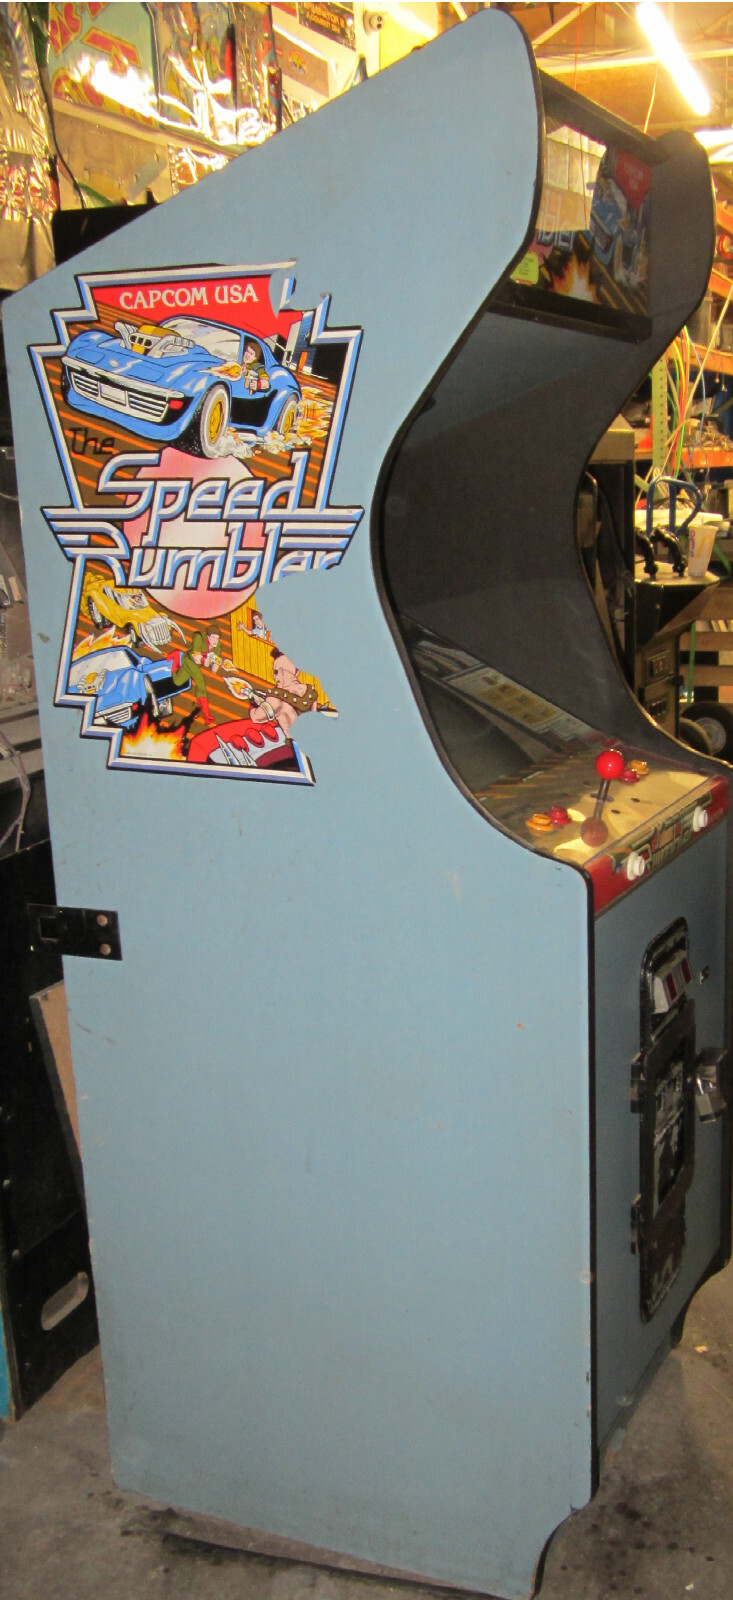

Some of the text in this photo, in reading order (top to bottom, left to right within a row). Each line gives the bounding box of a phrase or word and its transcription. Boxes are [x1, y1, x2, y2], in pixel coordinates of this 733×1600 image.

[119, 283, 259, 310] CAPCOM USA
[68, 427, 116, 456] The
[96, 449, 313, 547] Speed
